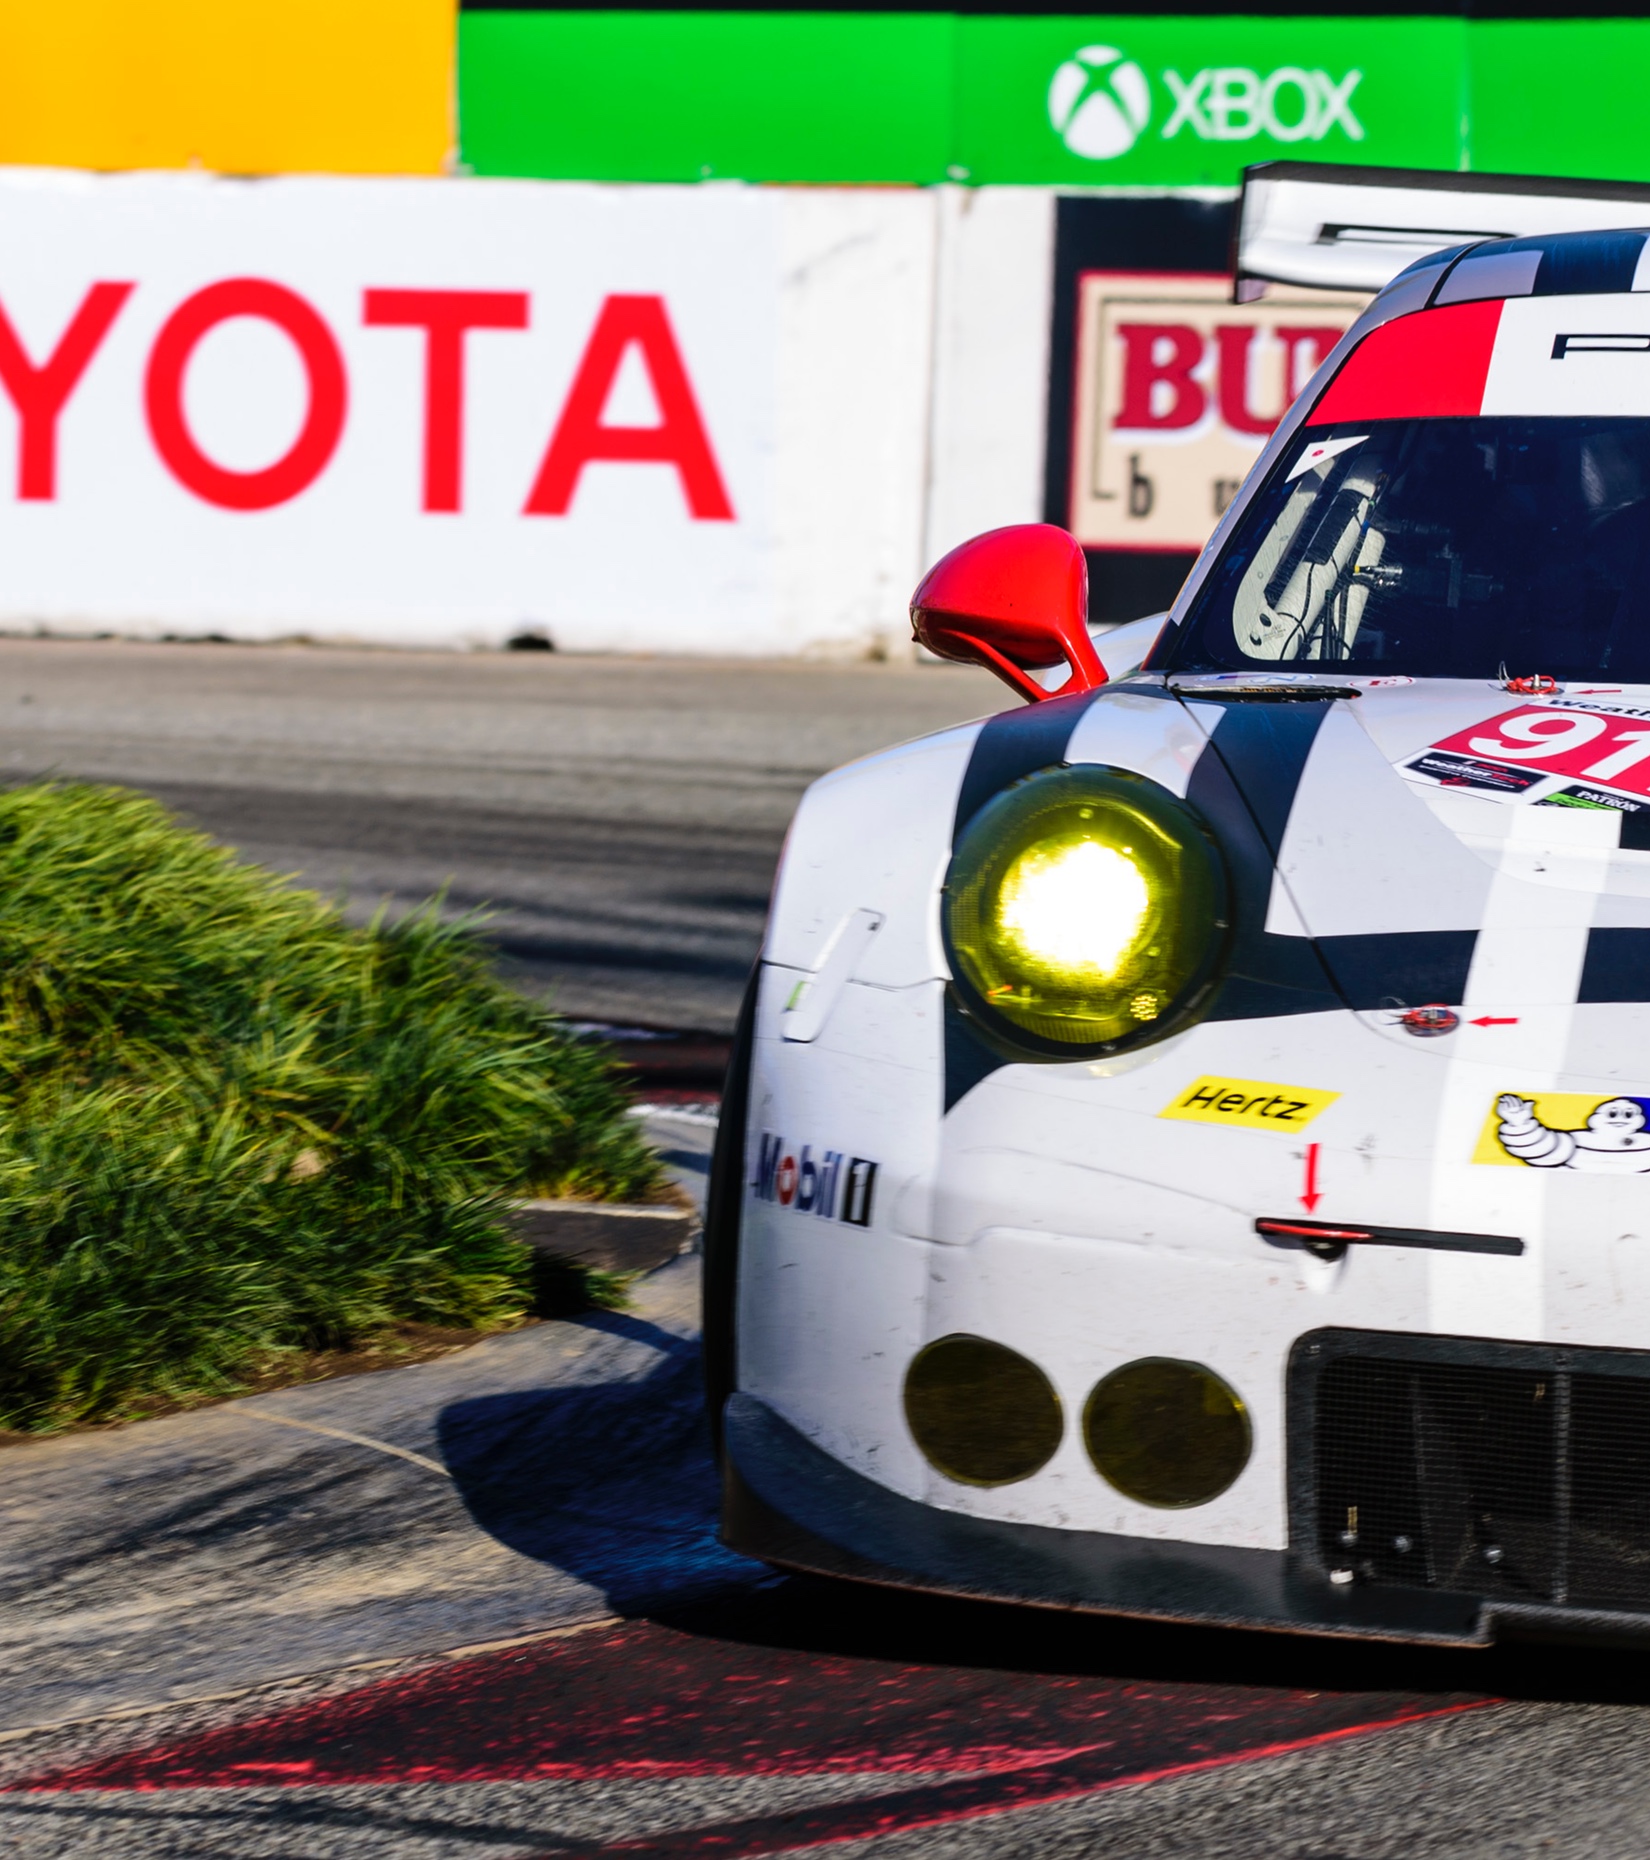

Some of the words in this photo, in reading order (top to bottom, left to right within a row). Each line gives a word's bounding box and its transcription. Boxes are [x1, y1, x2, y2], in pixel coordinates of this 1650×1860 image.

[1161, 66, 1365, 141] XBOX
[0, 277, 737, 522] YOTA
[1182, 1086, 1309, 1121] Hertz
[754, 1133, 844, 1218] Mobil
